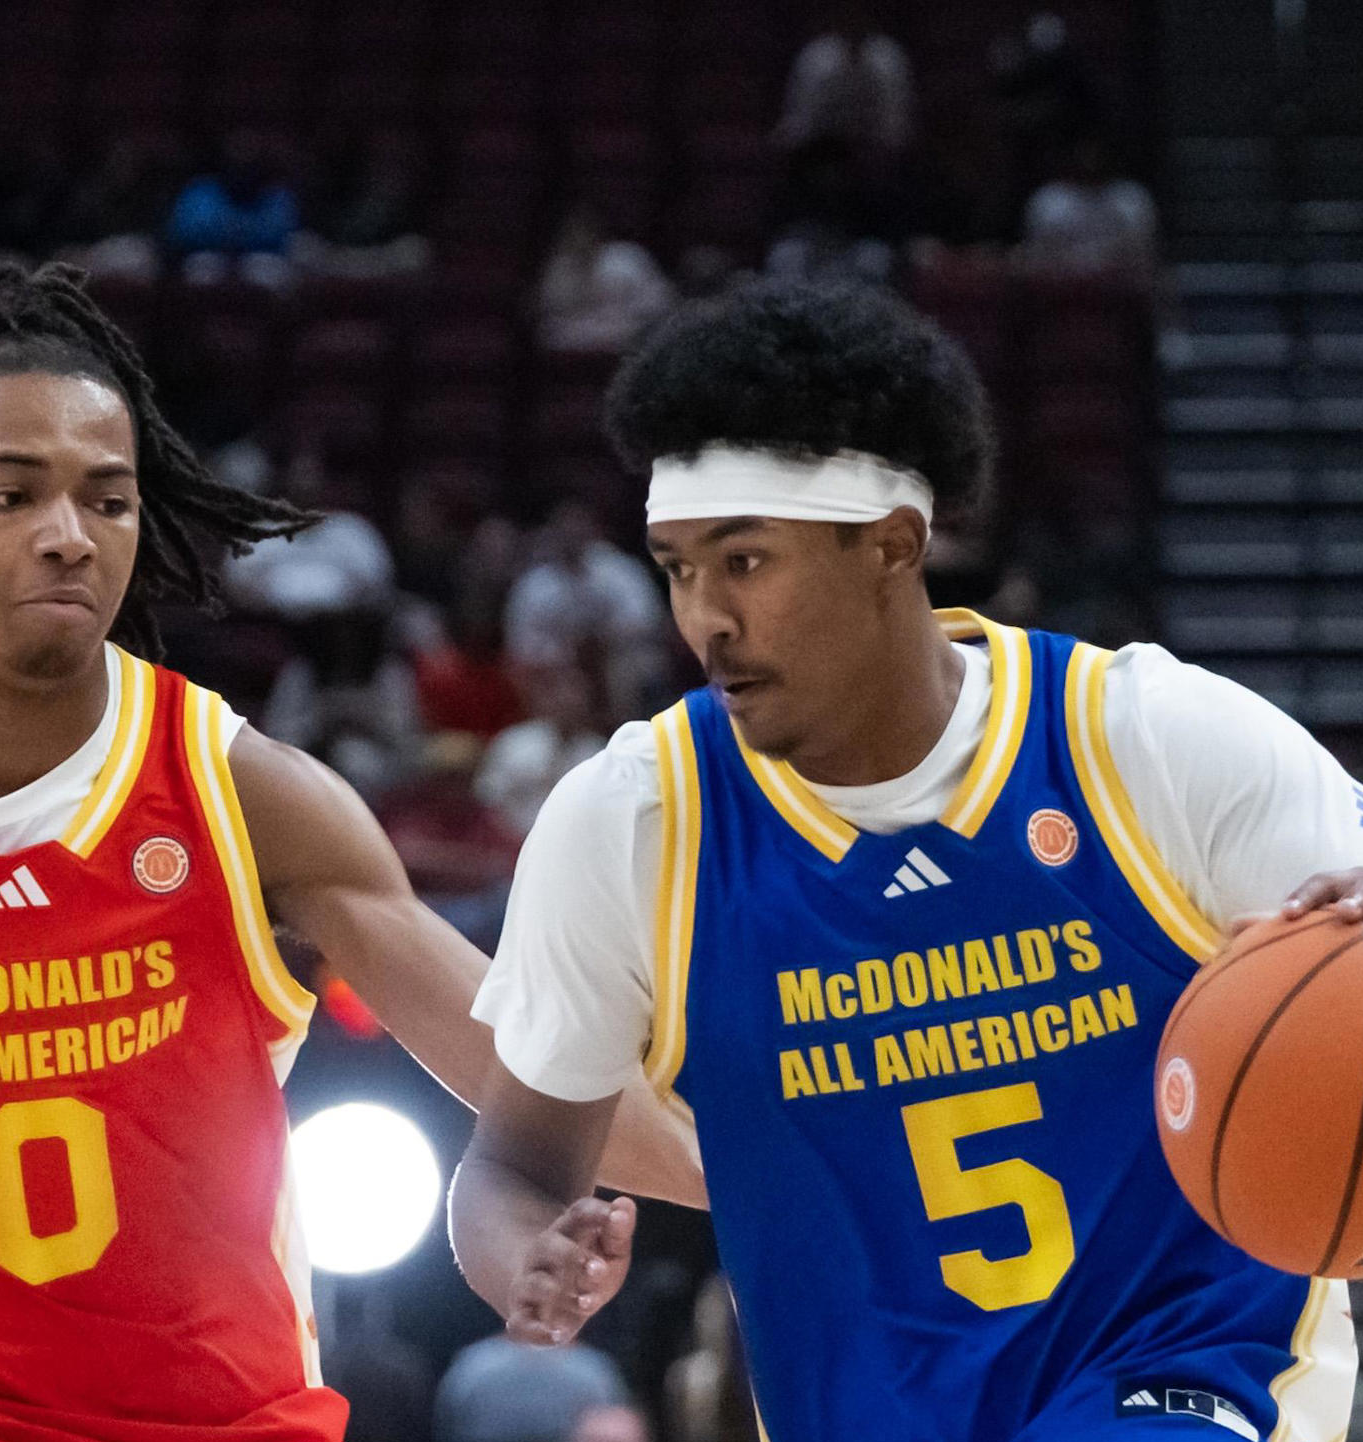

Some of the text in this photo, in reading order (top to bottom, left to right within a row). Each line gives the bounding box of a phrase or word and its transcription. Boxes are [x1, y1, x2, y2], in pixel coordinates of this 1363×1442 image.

[777, 919, 1102, 1025] McDONALD'S
[779, 984, 1138, 1100] ALL AMERICAN
[901, 1081, 1076, 1311] 5
